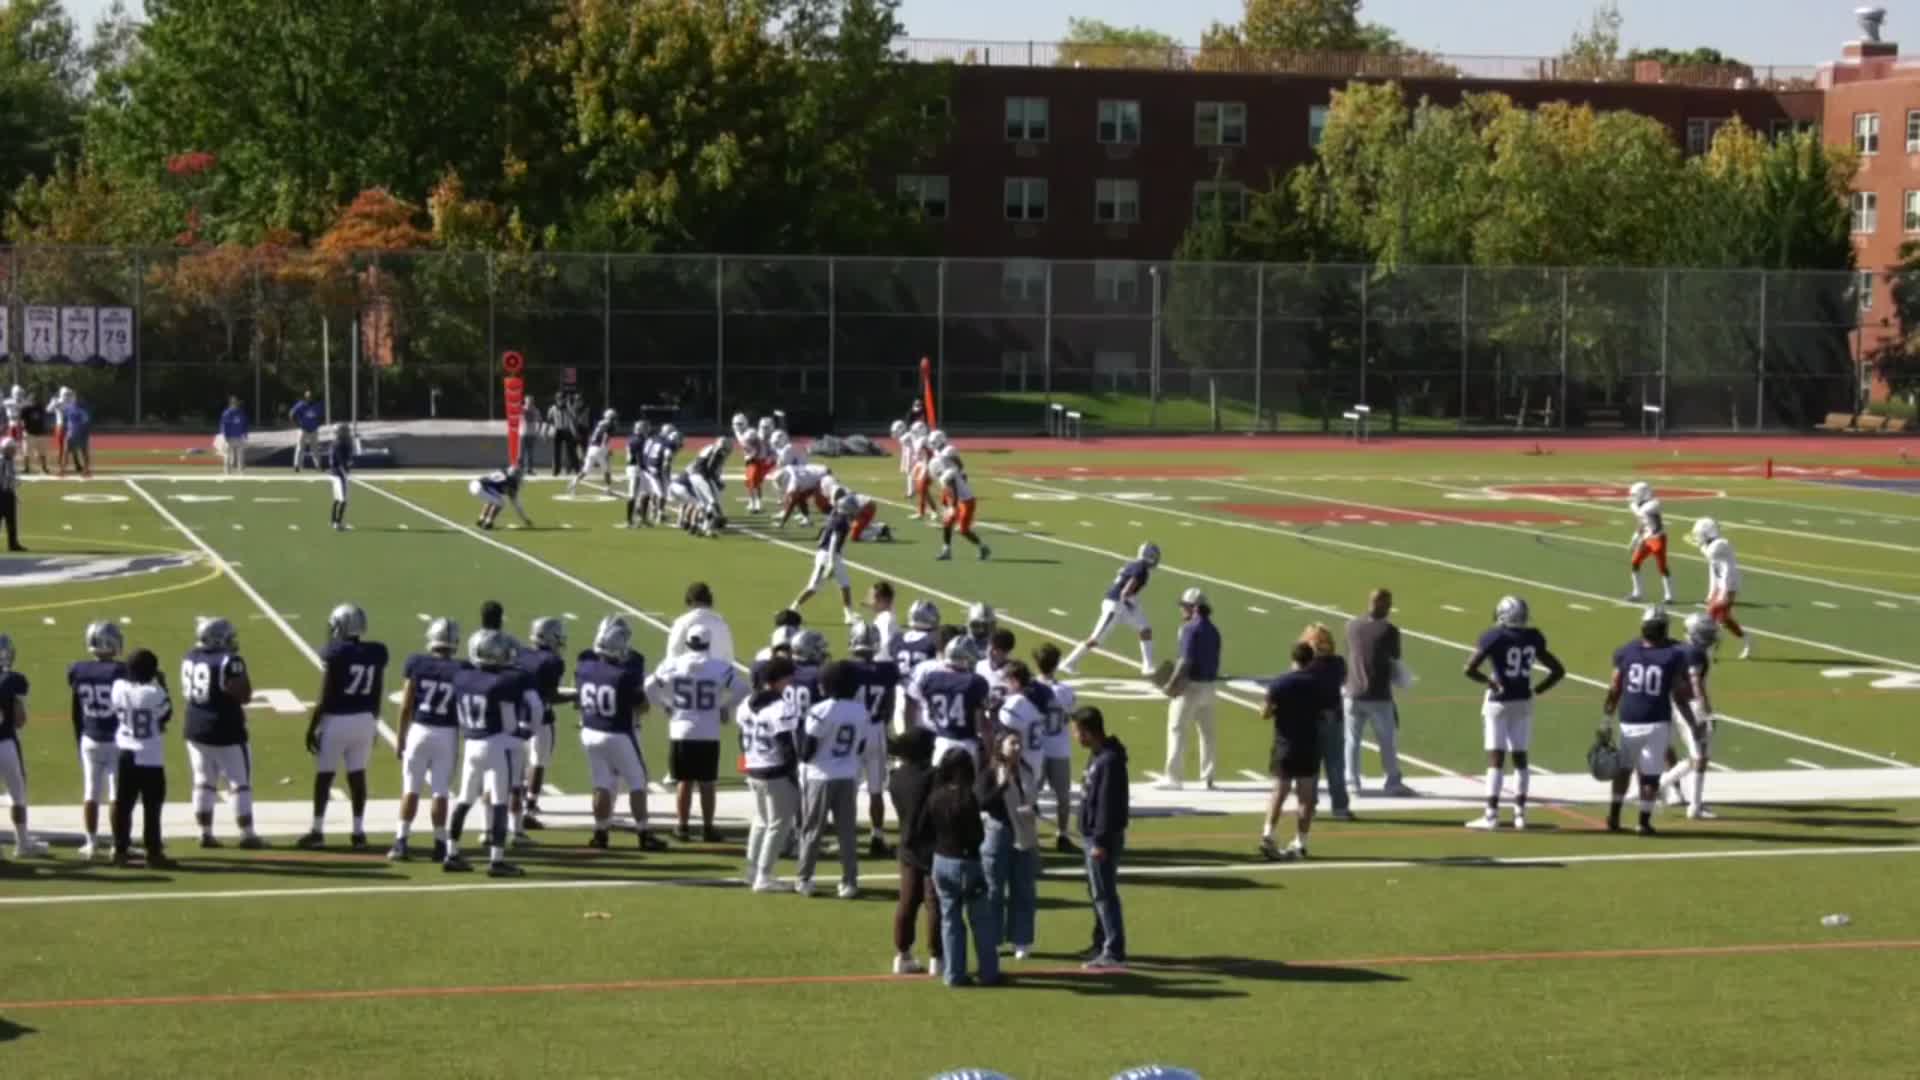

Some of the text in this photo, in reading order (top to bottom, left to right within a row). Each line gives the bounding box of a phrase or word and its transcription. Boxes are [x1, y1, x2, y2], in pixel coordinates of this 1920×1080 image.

[66, 328, 90, 344] 77
[1505, 647, 1536, 677] 93
[344, 664, 375, 695] 71
[673, 679, 717, 711] 56
[1627, 664, 1664, 696] 90
[580, 683, 616, 717] 60
[931, 693, 968, 728] 34
[831, 724, 856, 758] 9
